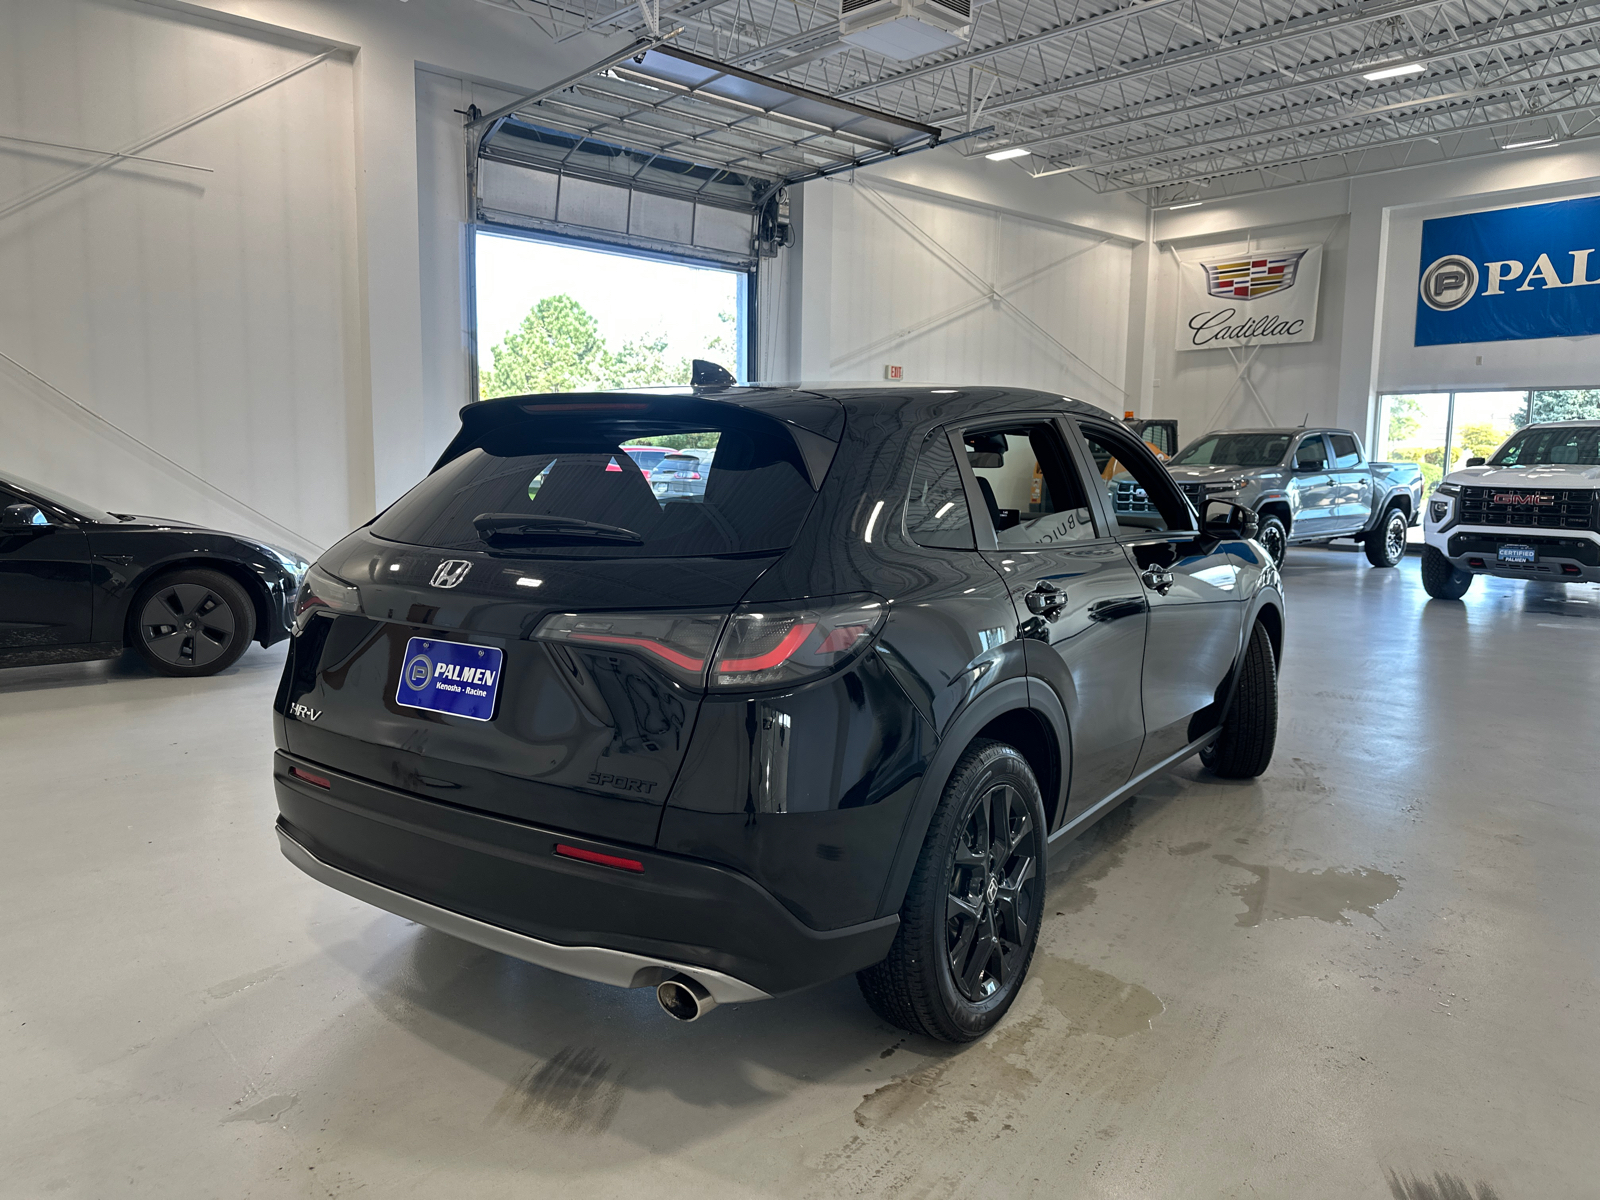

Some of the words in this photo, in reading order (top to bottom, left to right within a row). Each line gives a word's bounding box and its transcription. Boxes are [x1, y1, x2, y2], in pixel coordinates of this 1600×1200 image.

[1481, 248, 1600, 296] PAL
[1188, 307, 1304, 345] Cadillac
[890, 365, 902, 378] EXIT
[1494, 494, 1554, 506] GMC
[1499, 549, 1535, 557] CERTIFIED
[434, 662, 496, 686] PALMEN
[436, 681, 461, 693] Kenosha
[465, 686, 487, 698] Racine
[290, 702, 323, 721] HR-V
[587, 772, 657, 794] SPORT
